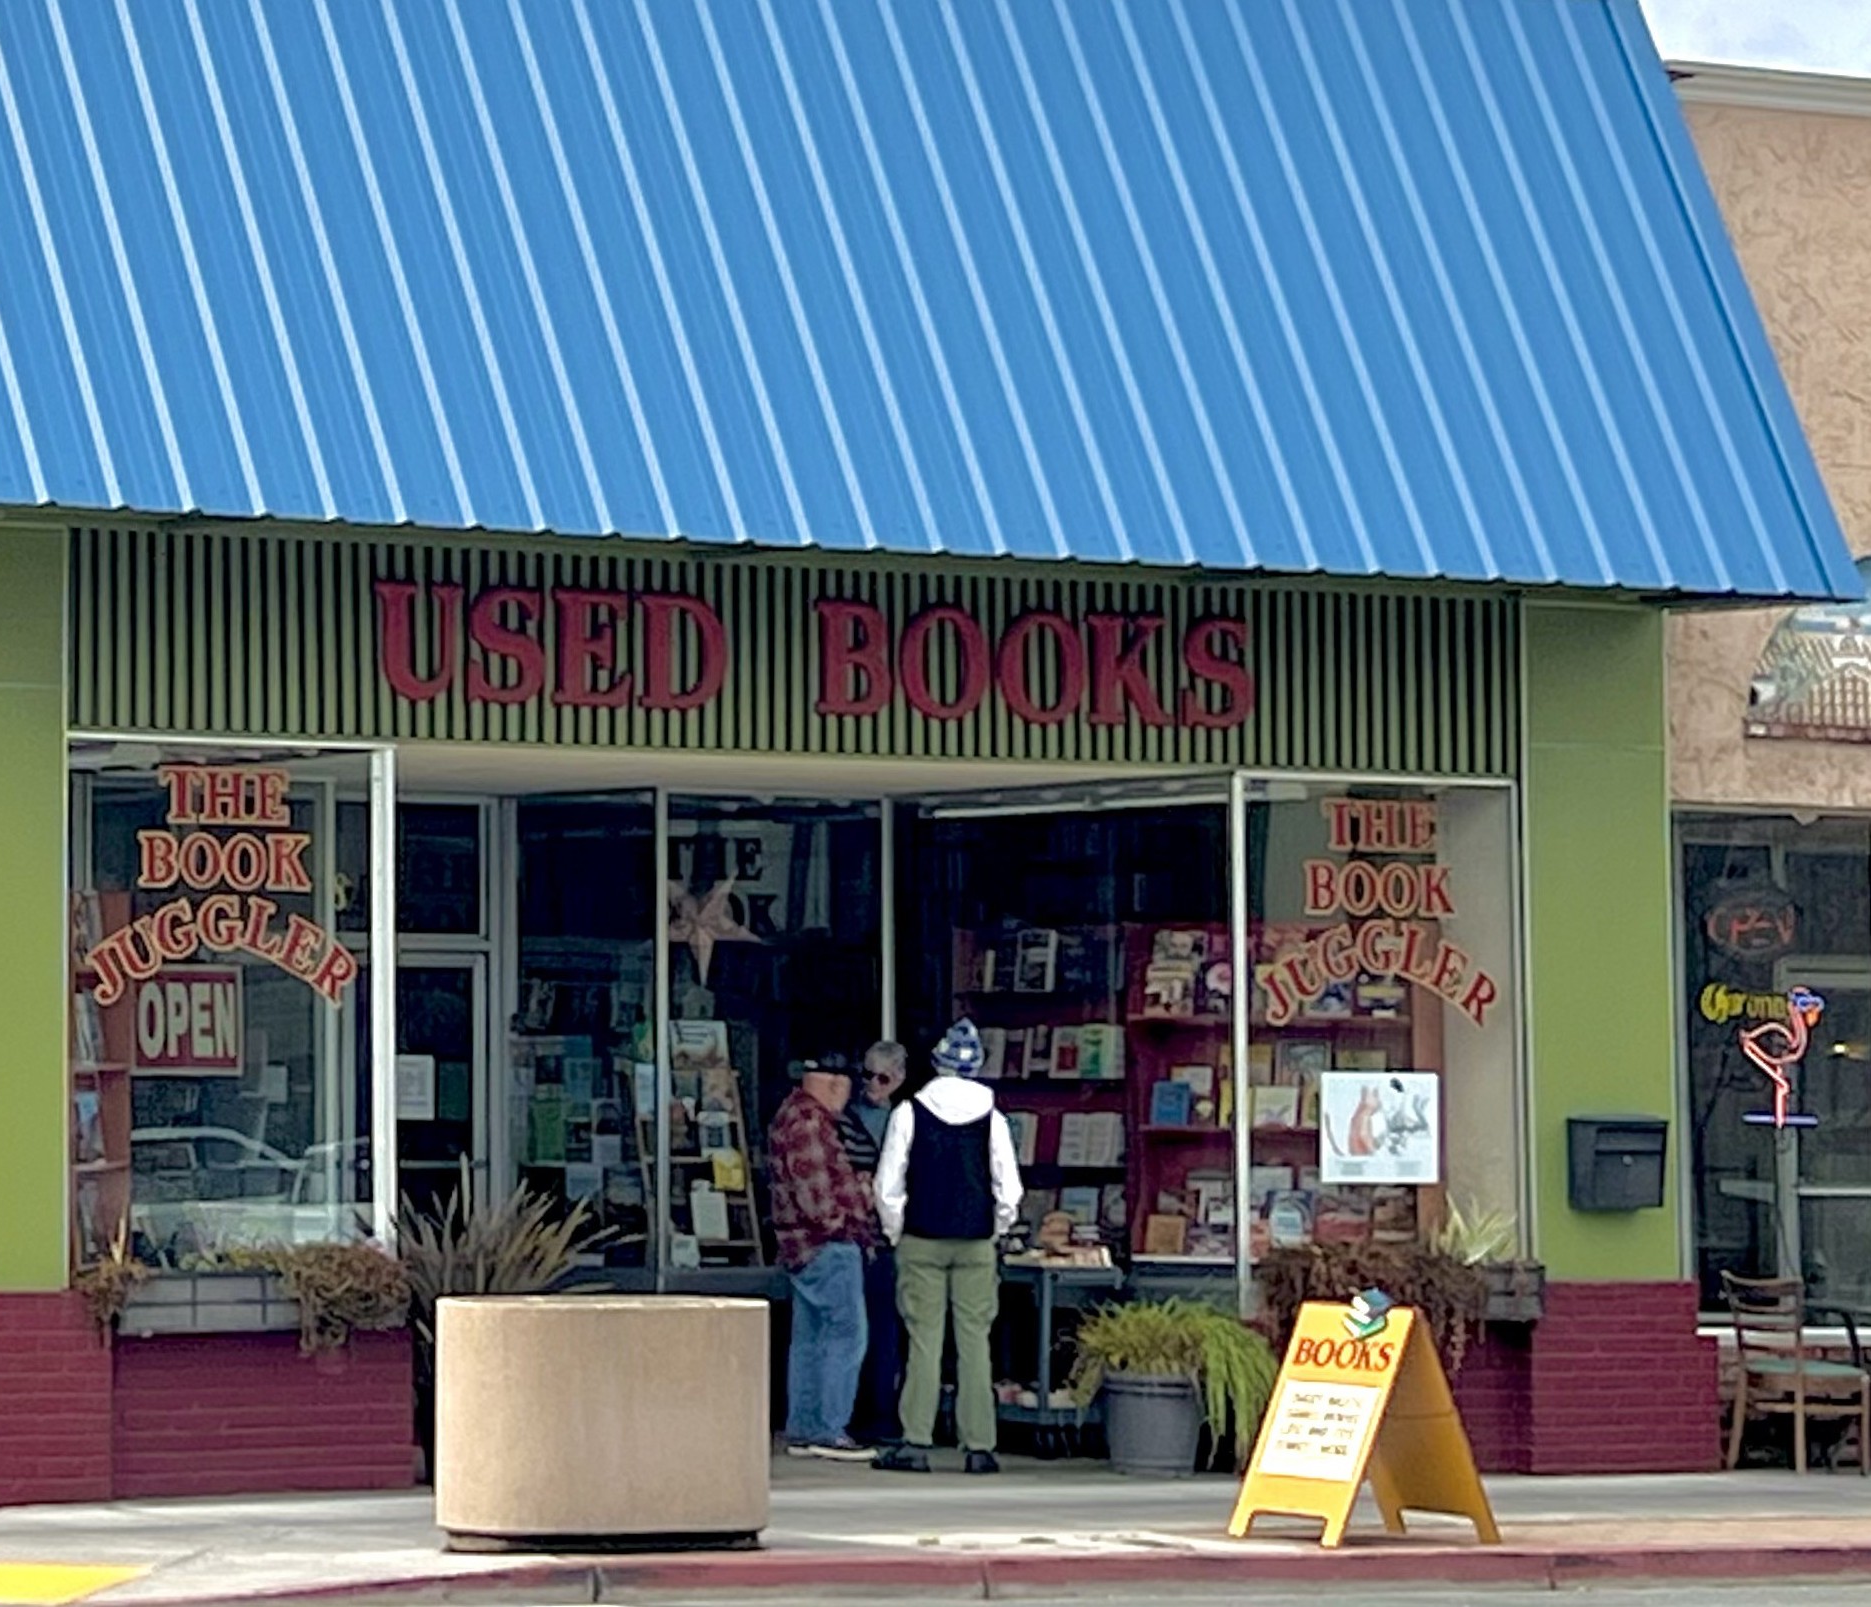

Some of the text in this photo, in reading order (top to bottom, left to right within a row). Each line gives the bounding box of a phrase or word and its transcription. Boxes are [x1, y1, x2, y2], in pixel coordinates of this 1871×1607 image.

[373, 579, 1255, 731] USED BOOKS
[158, 764, 291, 827] THE
[1320, 798, 1437, 853] THE
[137, 829, 312, 893] BOOK
[1303, 859, 1456, 917] BOOK
[84, 895, 358, 1008] JUGGLER
[1256, 917, 1498, 1028] JUGGLER
[138, 981, 237, 1060] OPEN
[1293, 1337, 1395, 1373] BOOKS
